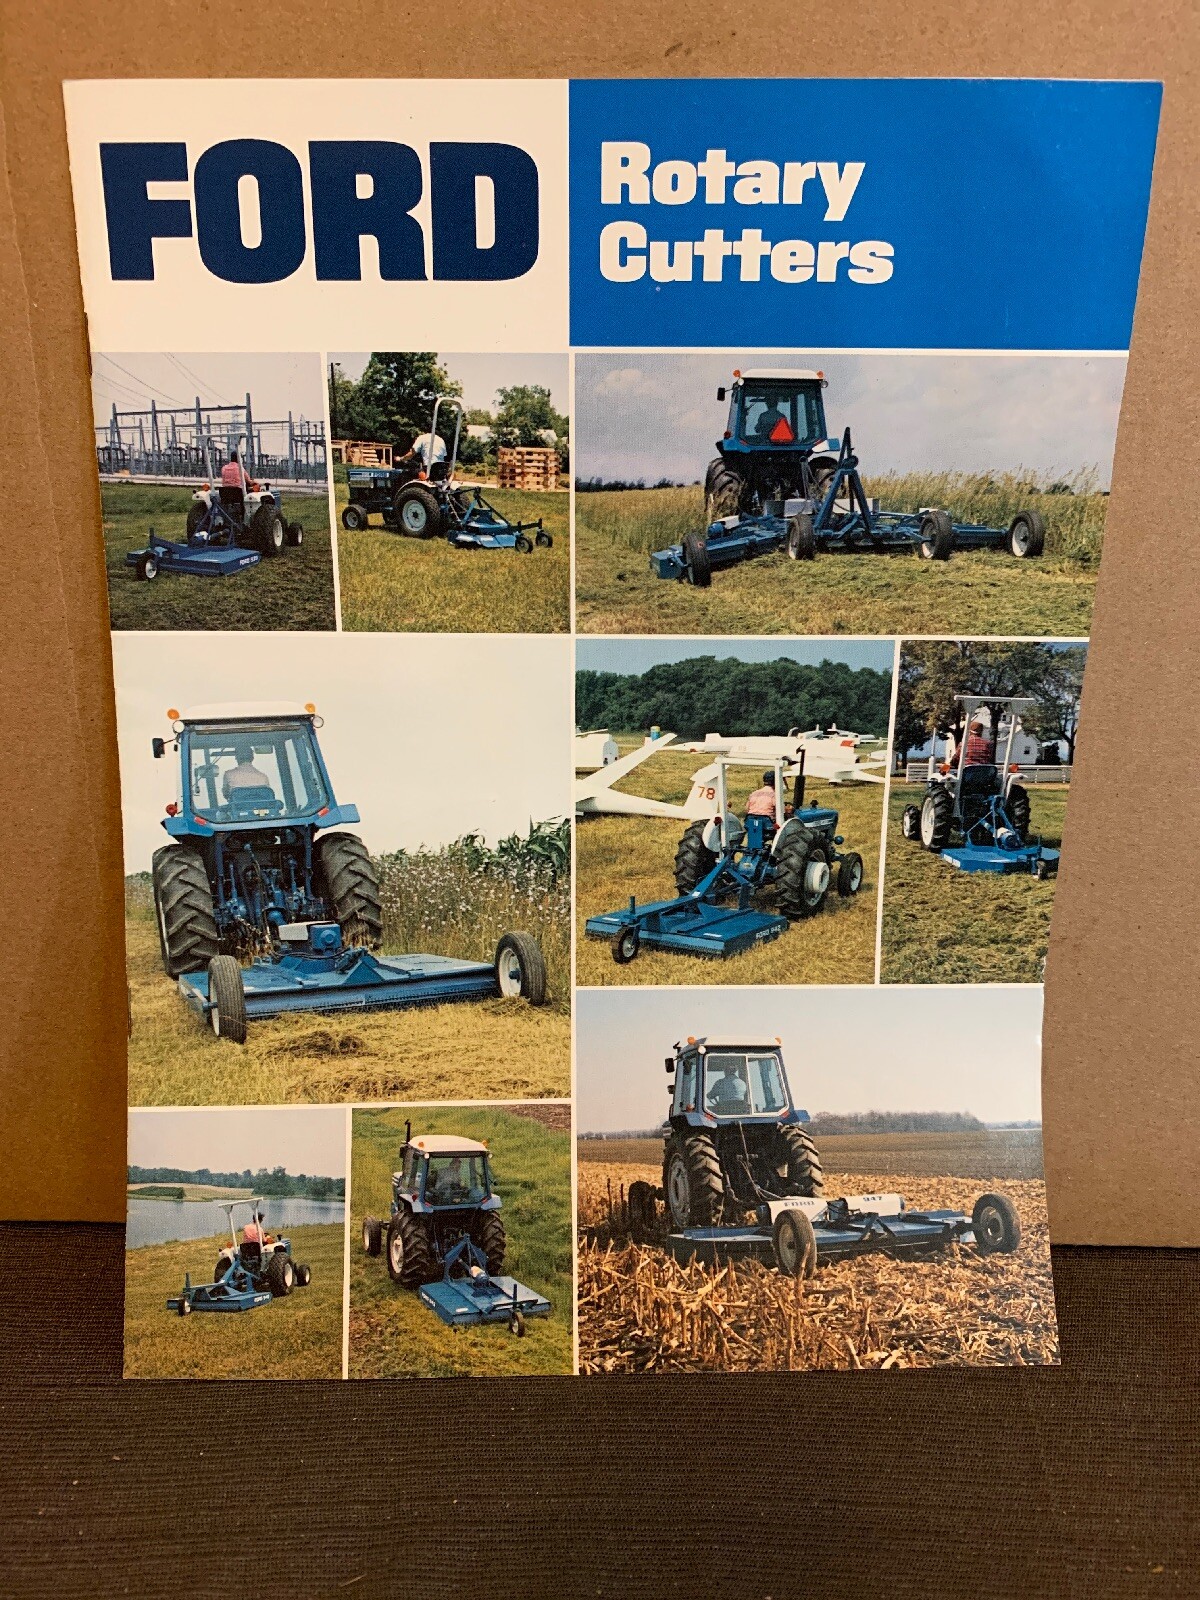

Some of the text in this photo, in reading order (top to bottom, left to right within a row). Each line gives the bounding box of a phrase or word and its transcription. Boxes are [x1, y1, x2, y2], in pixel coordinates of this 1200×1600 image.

[99, 138, 538, 284] FORD
[600, 141, 866, 221] Rotary
[600, 221, 895, 284] Cutters
[697, 786, 715, 800] 78
[755, 928, 770, 940] FORD
